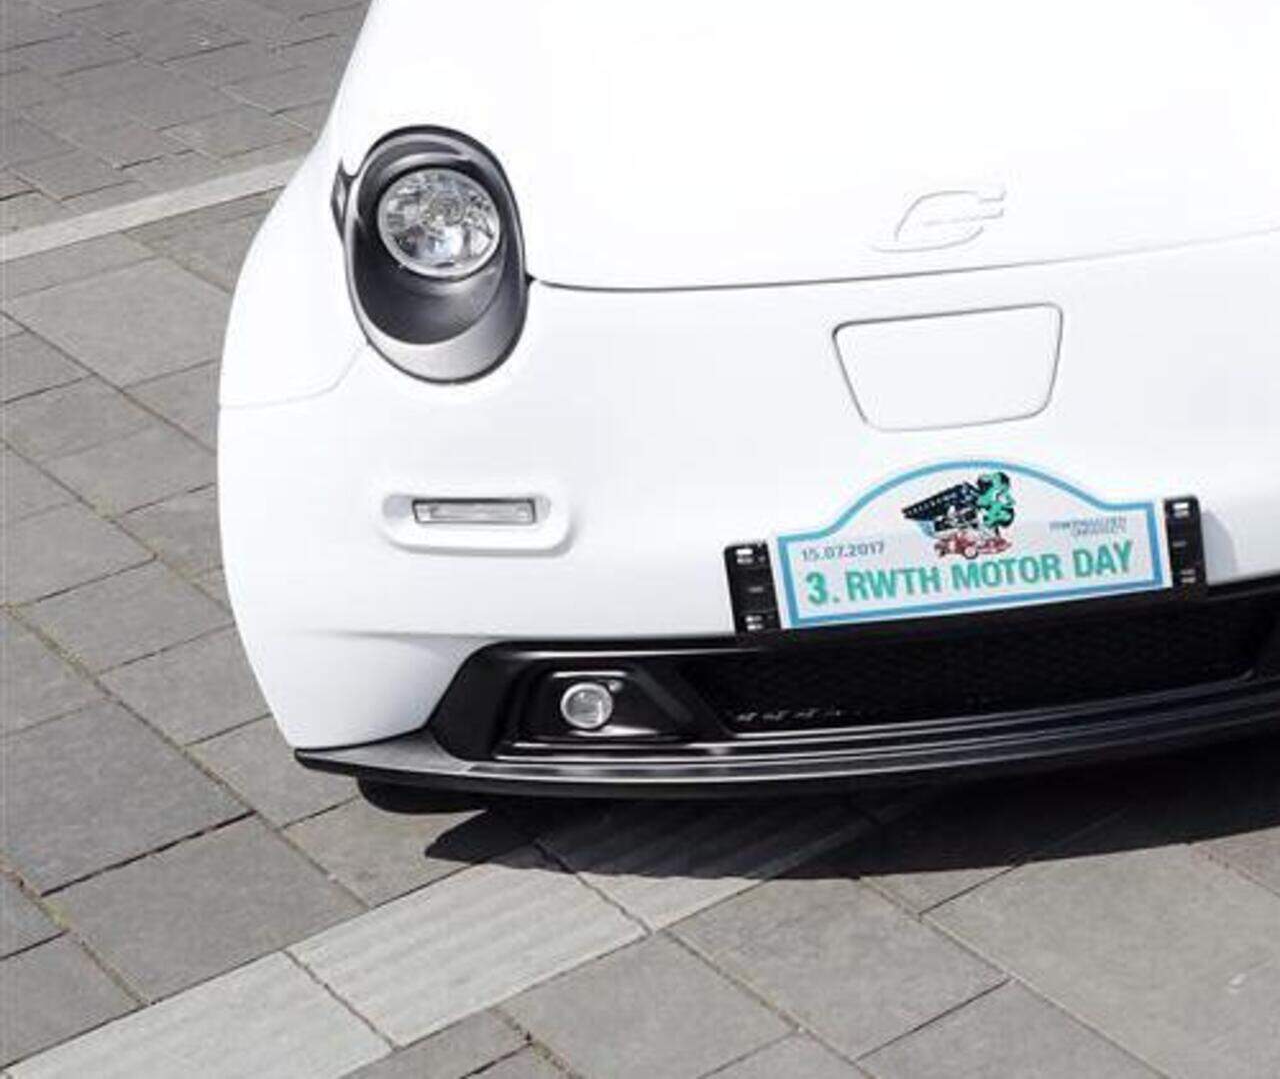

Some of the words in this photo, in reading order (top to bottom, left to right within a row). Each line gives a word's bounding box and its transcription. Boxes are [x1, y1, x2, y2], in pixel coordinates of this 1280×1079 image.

[802, 540, 884, 562] 15.07.2017
[805, 571, 840, 604] 3.
[845, 566, 941, 602] RWTH
[951, 553, 1063, 590] MOTOR
[1072, 538, 1132, 578] DAY
